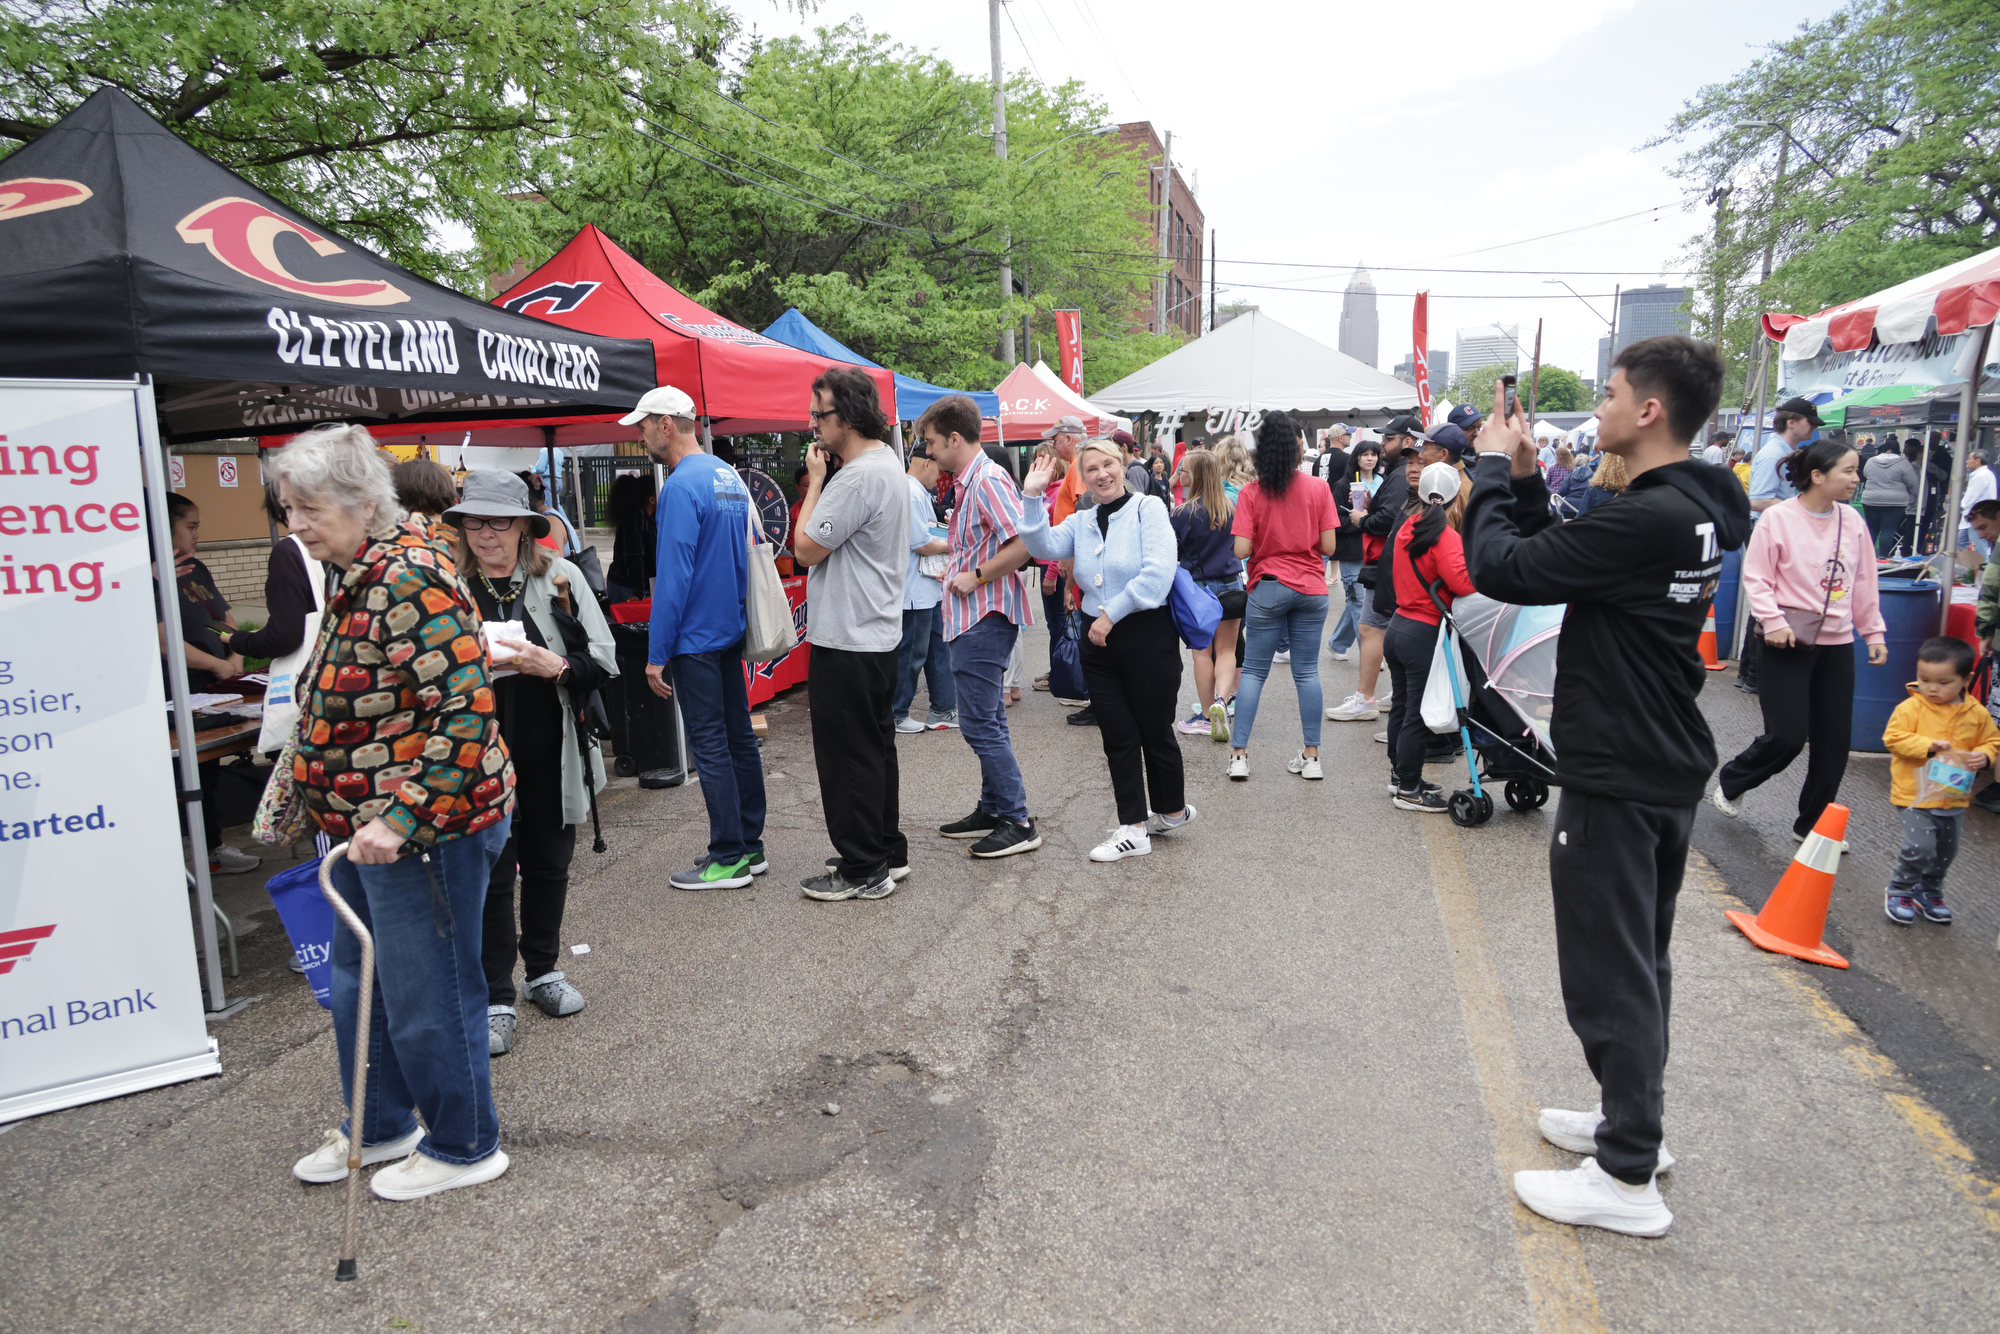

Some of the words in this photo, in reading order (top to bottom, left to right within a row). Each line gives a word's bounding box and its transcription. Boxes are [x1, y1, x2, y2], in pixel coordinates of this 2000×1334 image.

[267, 307, 460, 374] CLEVELAND
[477, 328, 601, 391] CAVALIERS
[1868, 367, 1907, 387] Found
[1205, 404, 1264, 435] The
[0, 434, 100, 486] ing
[0, 502, 140, 536] ence
[0, 554, 121, 602] ing.
[1669, 583, 1702, 594] ROCK
[0, 804, 116, 842] tarted.
[0, 1005, 57, 1039] nal
[66, 988, 158, 1026] Bank
